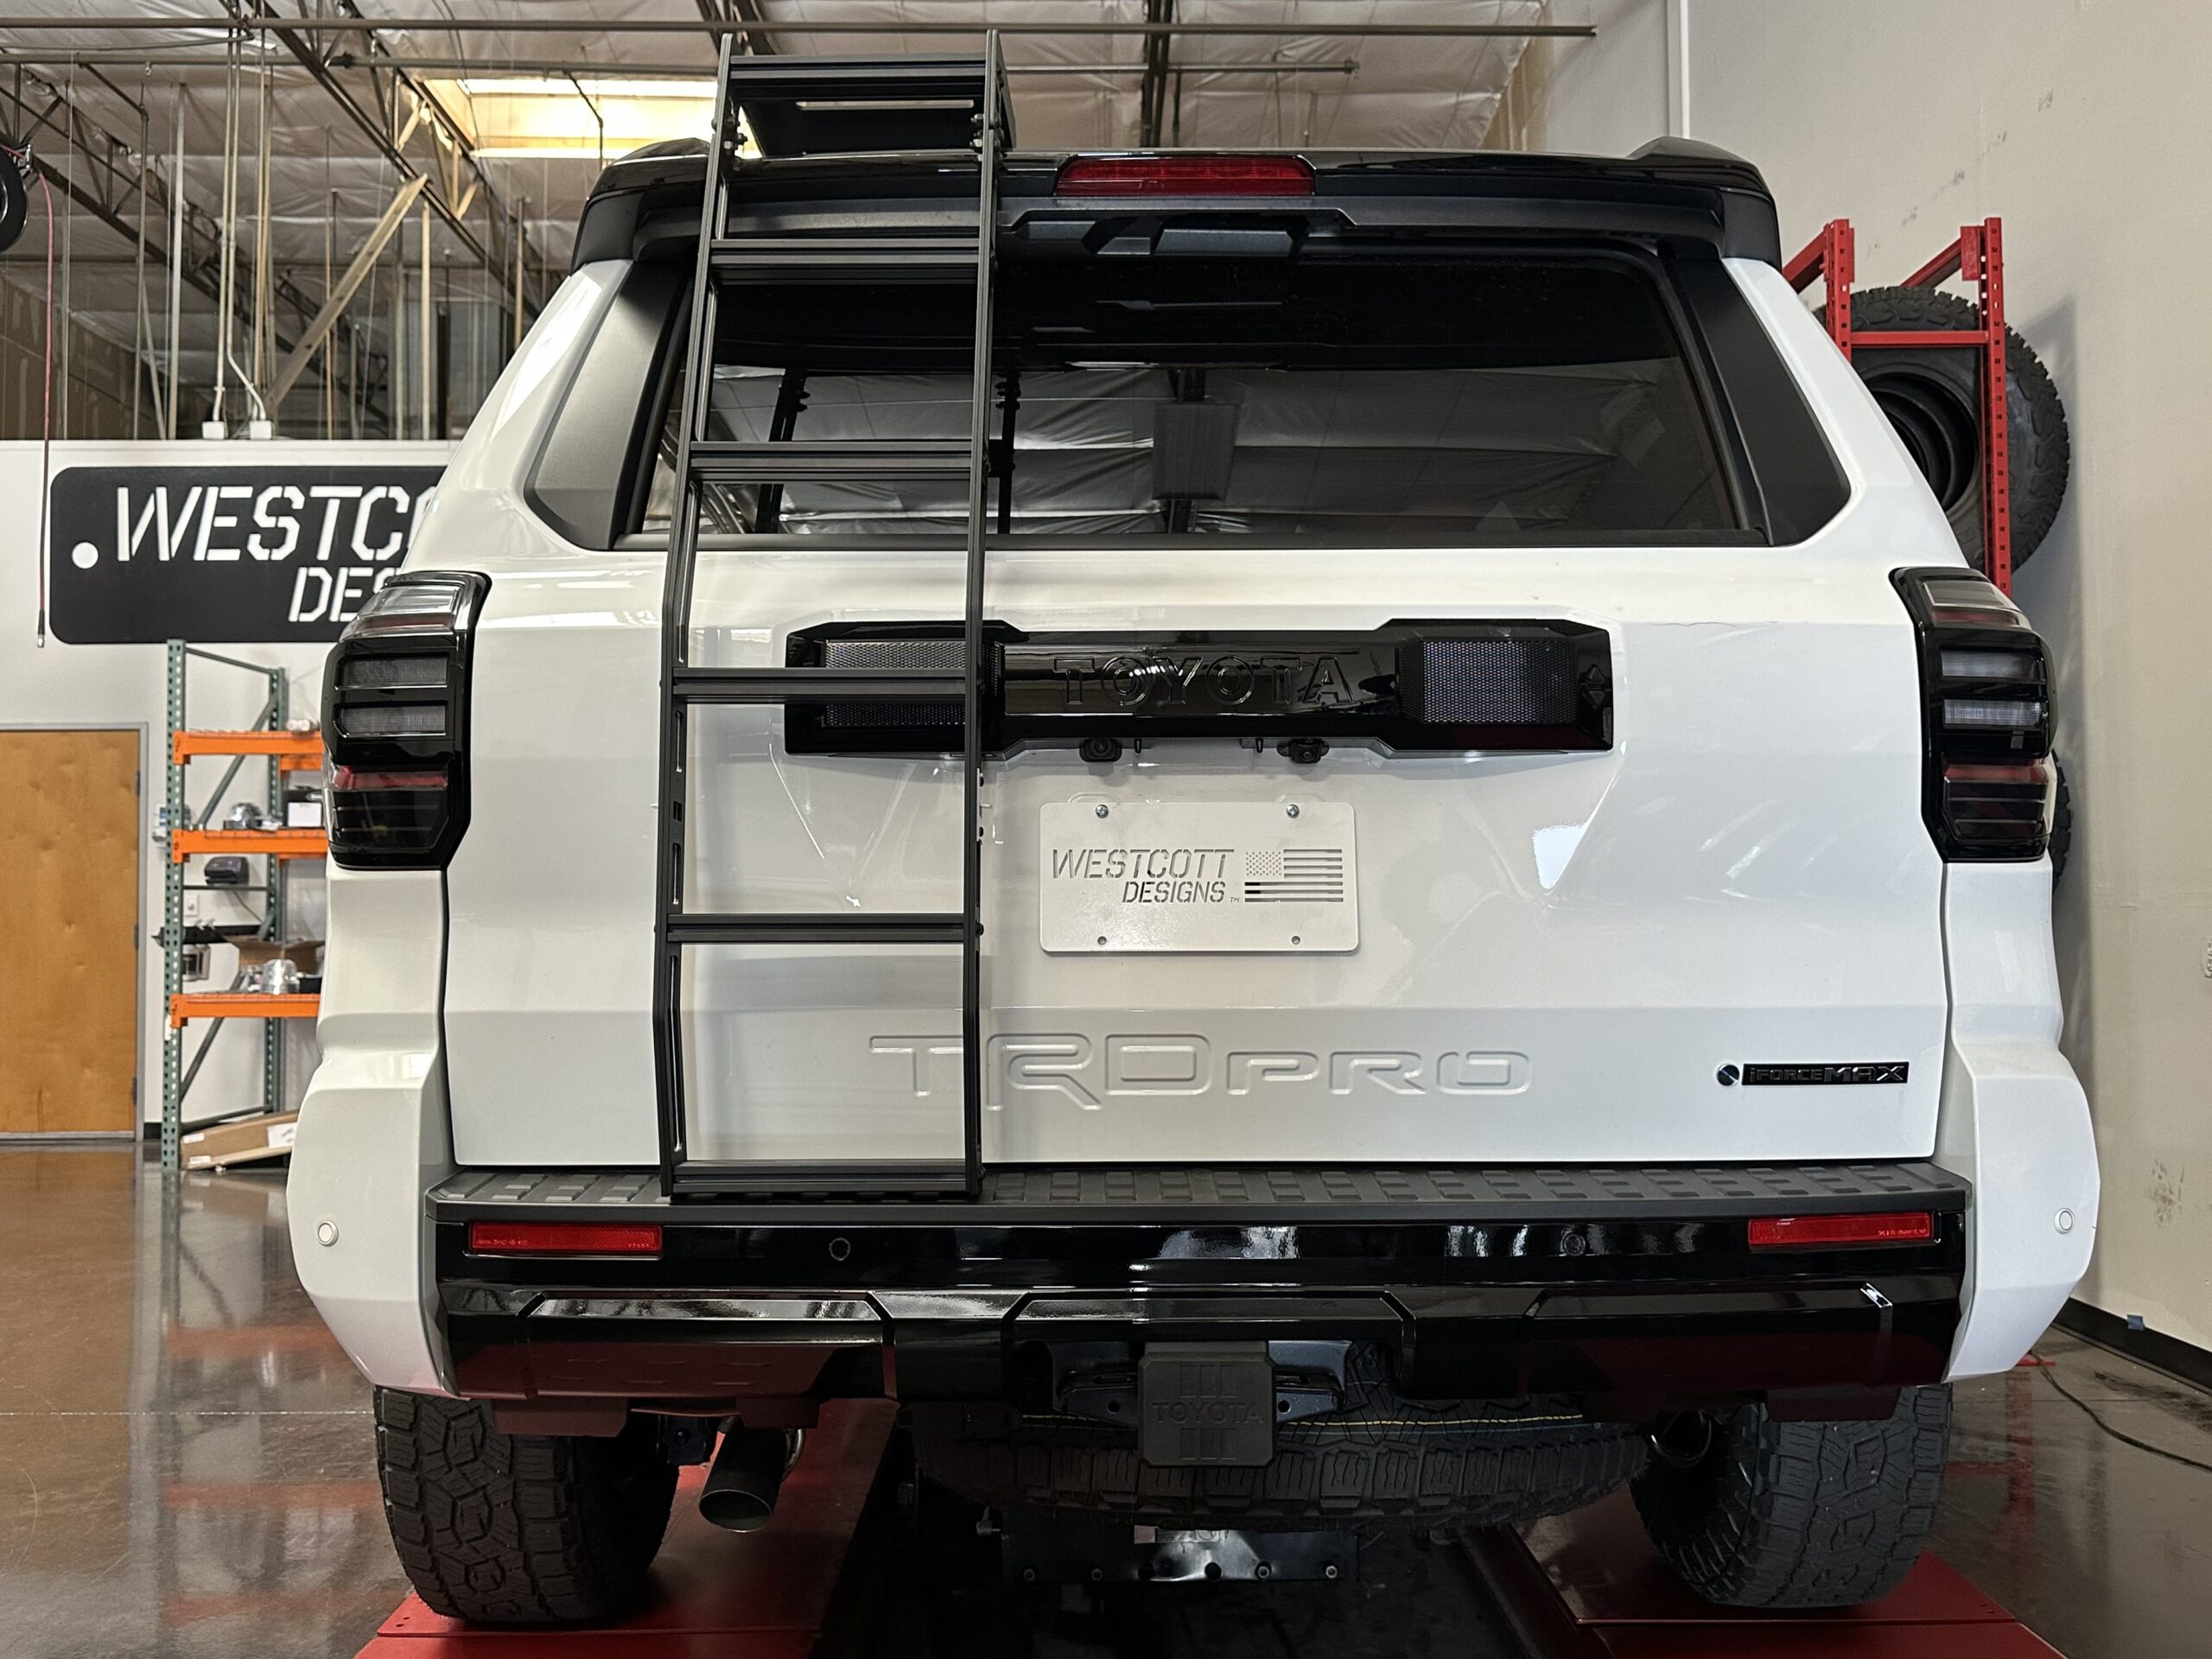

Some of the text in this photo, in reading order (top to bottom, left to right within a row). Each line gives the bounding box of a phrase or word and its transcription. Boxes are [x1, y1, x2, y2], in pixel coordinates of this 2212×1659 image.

[1052, 655, 1355, 707] TOYOTA
[1052, 849, 1235, 879] WESTCOTT
[1122, 881, 1227, 904] DESIGNS
[1152, 1401, 1265, 1425] TOYOTA
